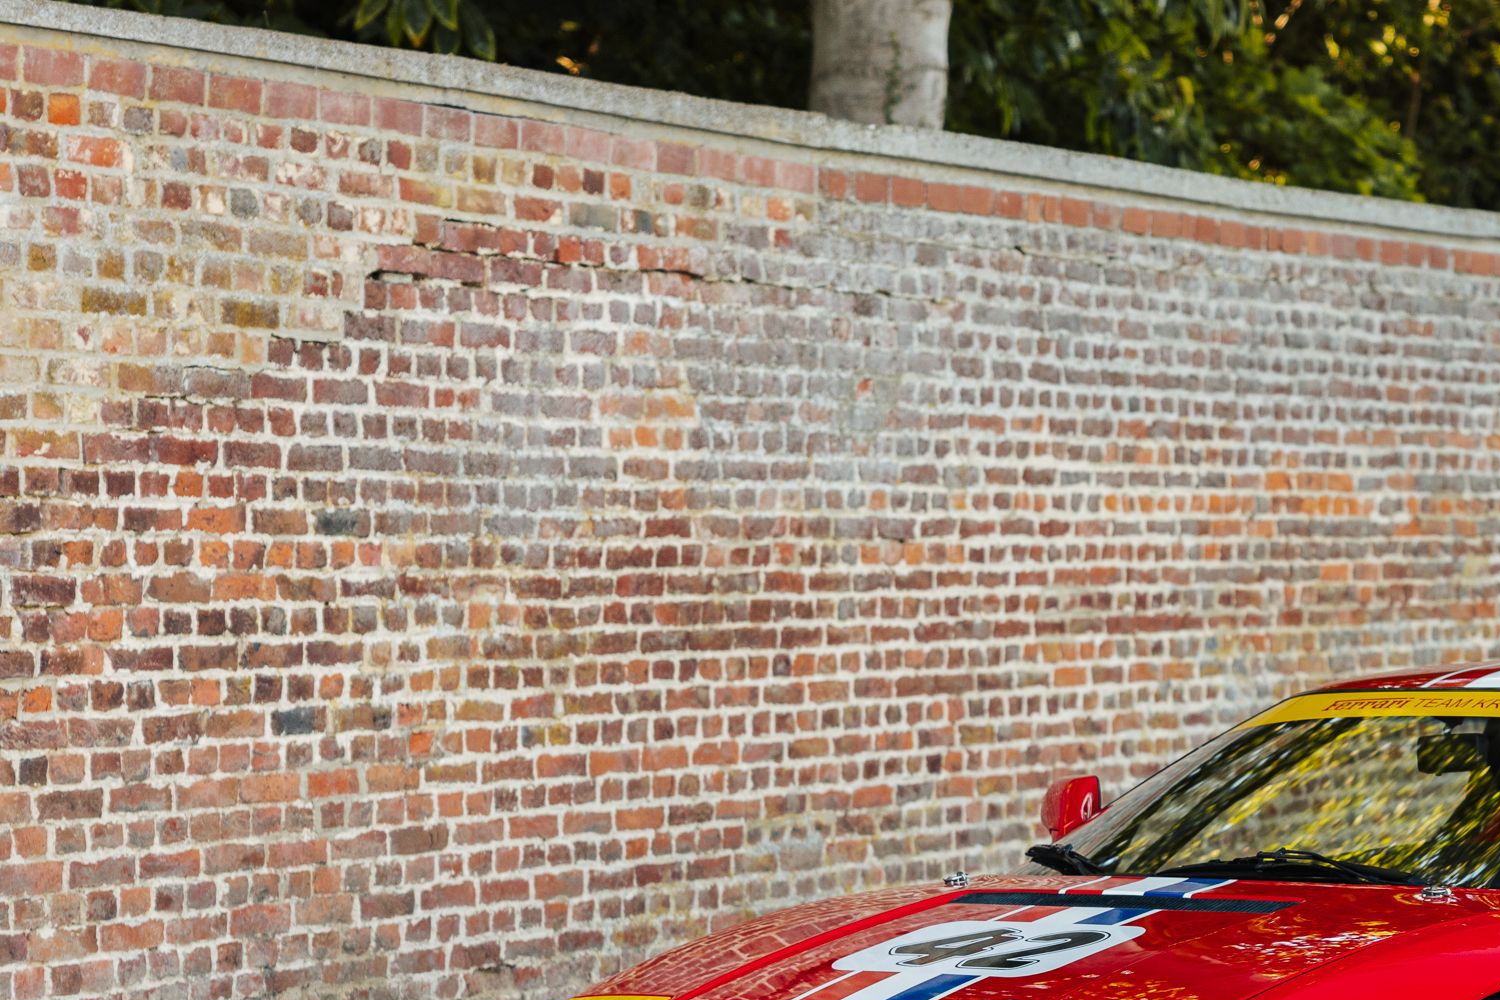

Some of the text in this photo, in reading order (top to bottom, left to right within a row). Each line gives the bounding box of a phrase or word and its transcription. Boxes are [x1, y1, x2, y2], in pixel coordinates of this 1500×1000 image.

[1321, 697, 1415, 712] Ferrari
[1414, 698, 1472, 709] TEAM
[888, 927, 1112, 971] 42
